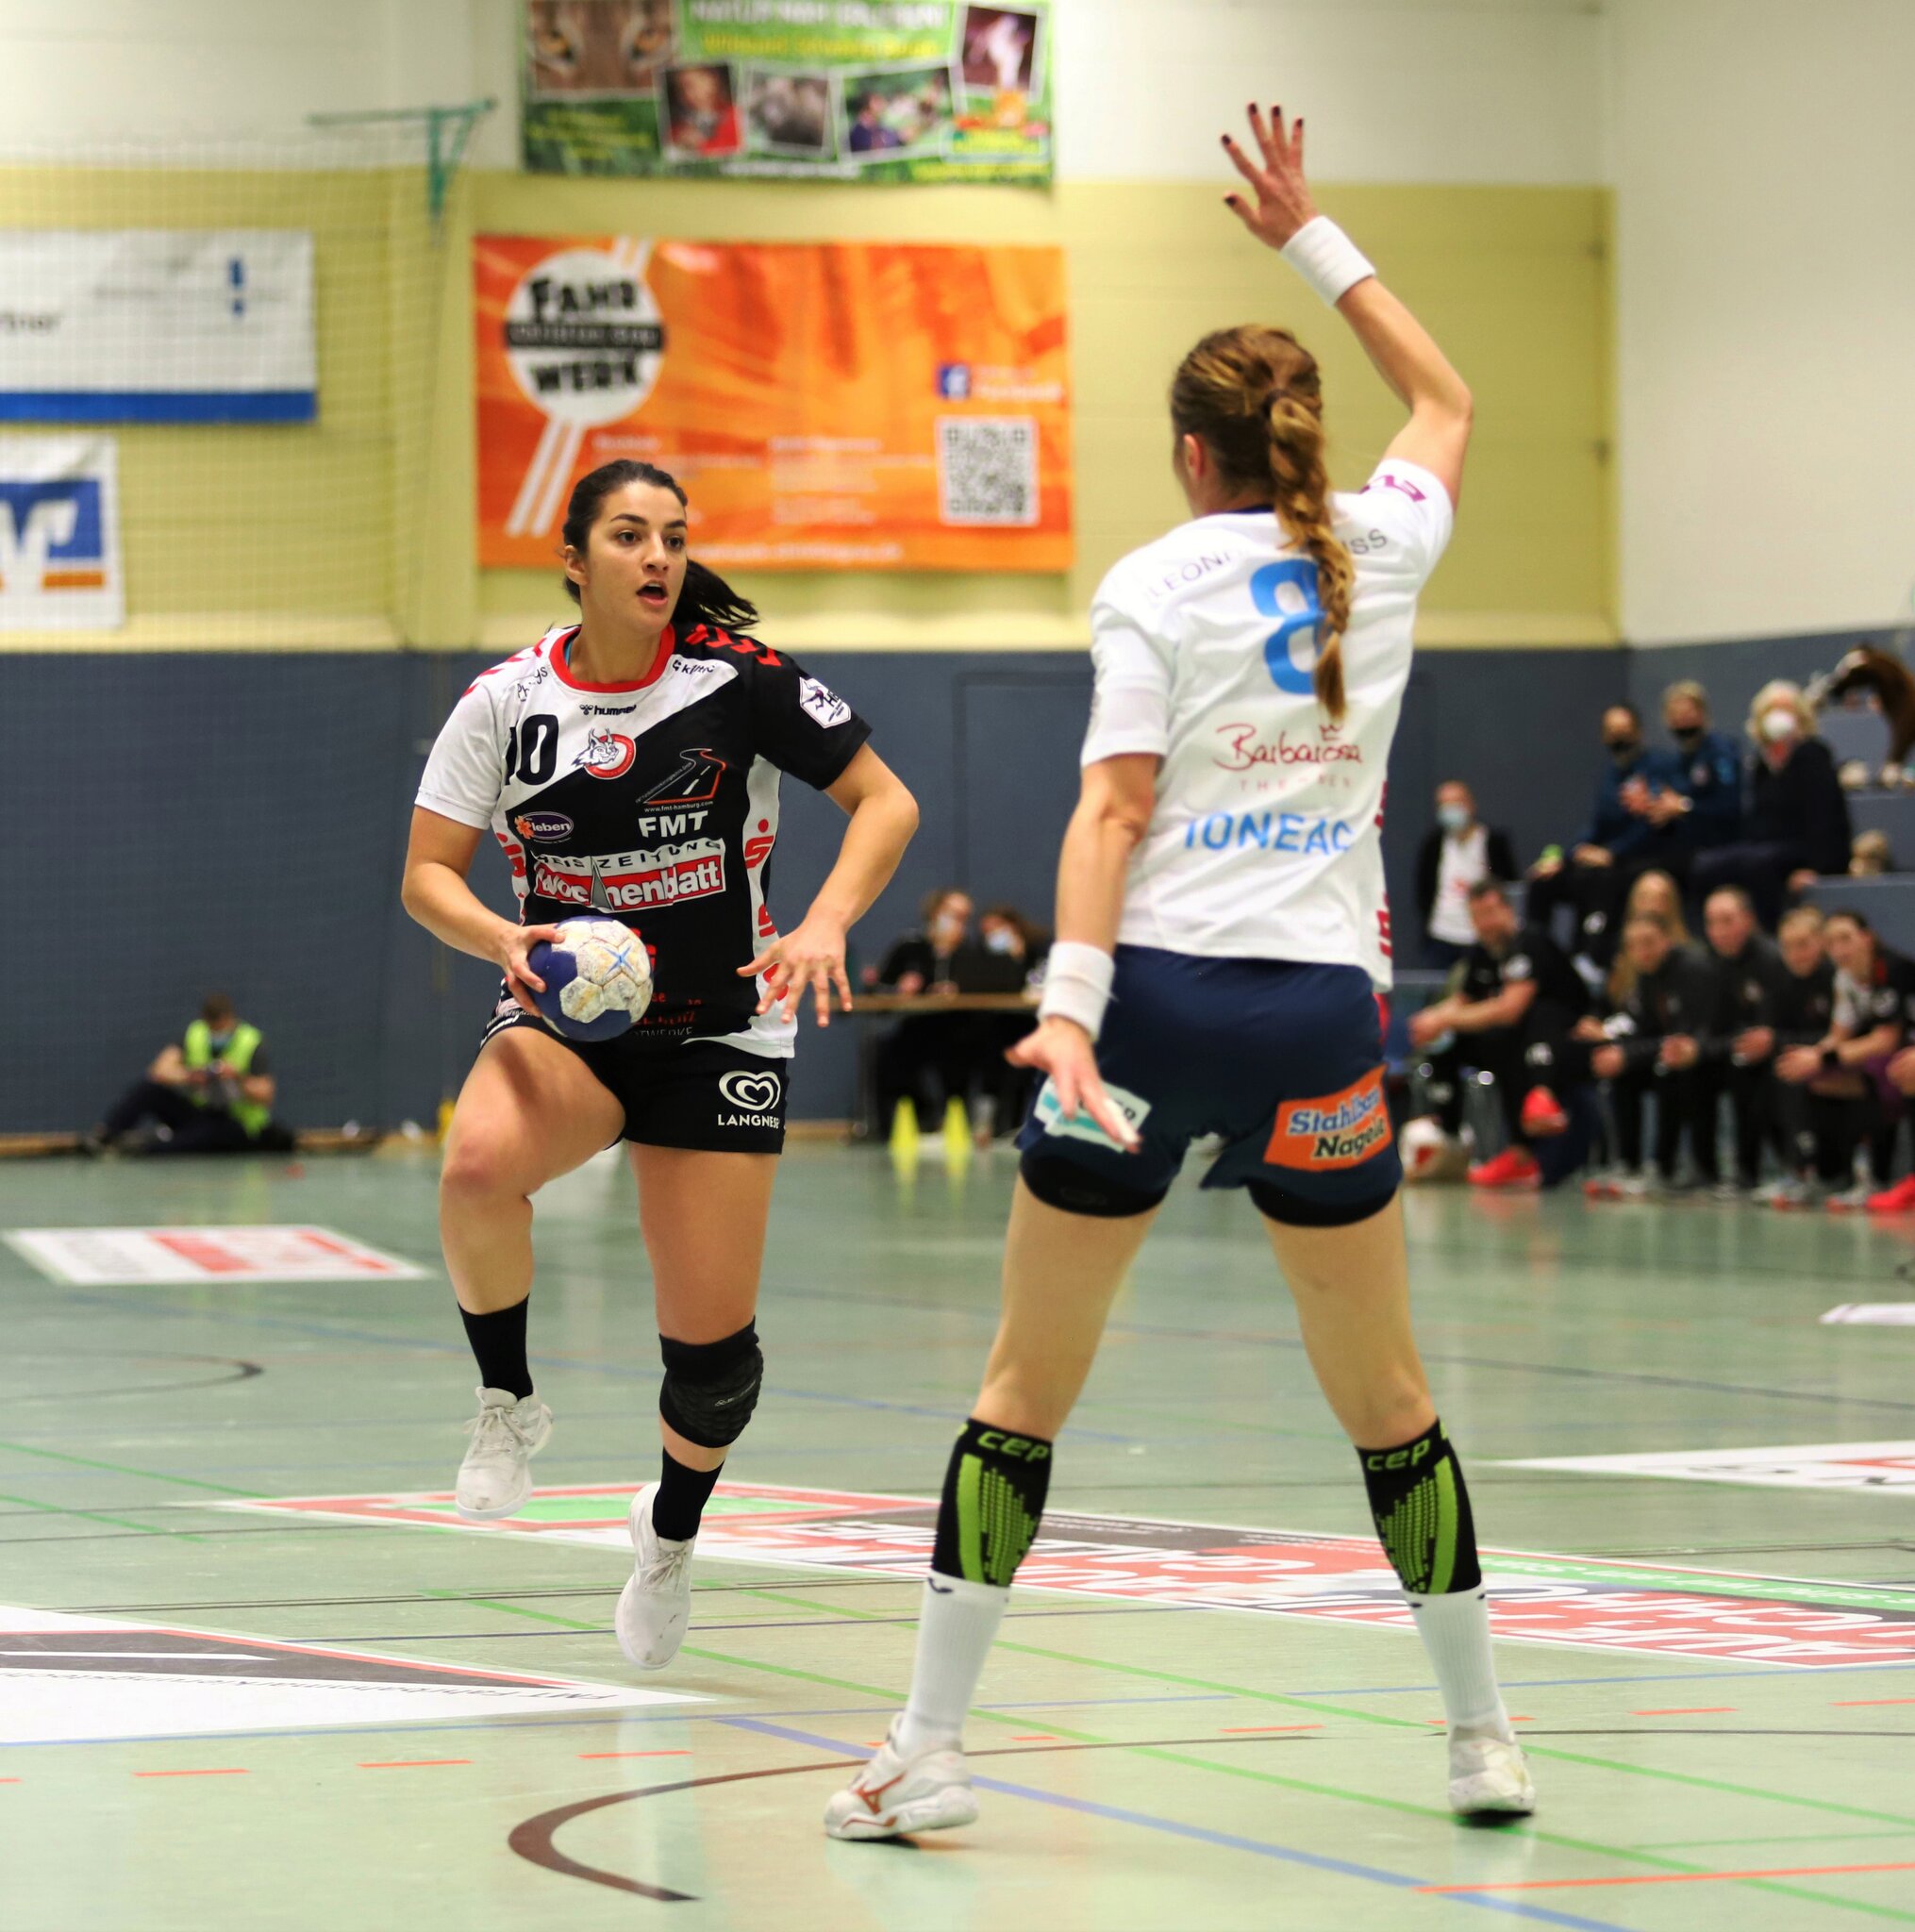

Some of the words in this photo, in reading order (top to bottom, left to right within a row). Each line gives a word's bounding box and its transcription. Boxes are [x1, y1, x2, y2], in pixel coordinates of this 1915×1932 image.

[1249, 558, 1327, 695] 8
[638, 811, 708, 838] FMT
[977, 1431, 1049, 1462] cep
[1367, 1439, 1430, 1471] cep
